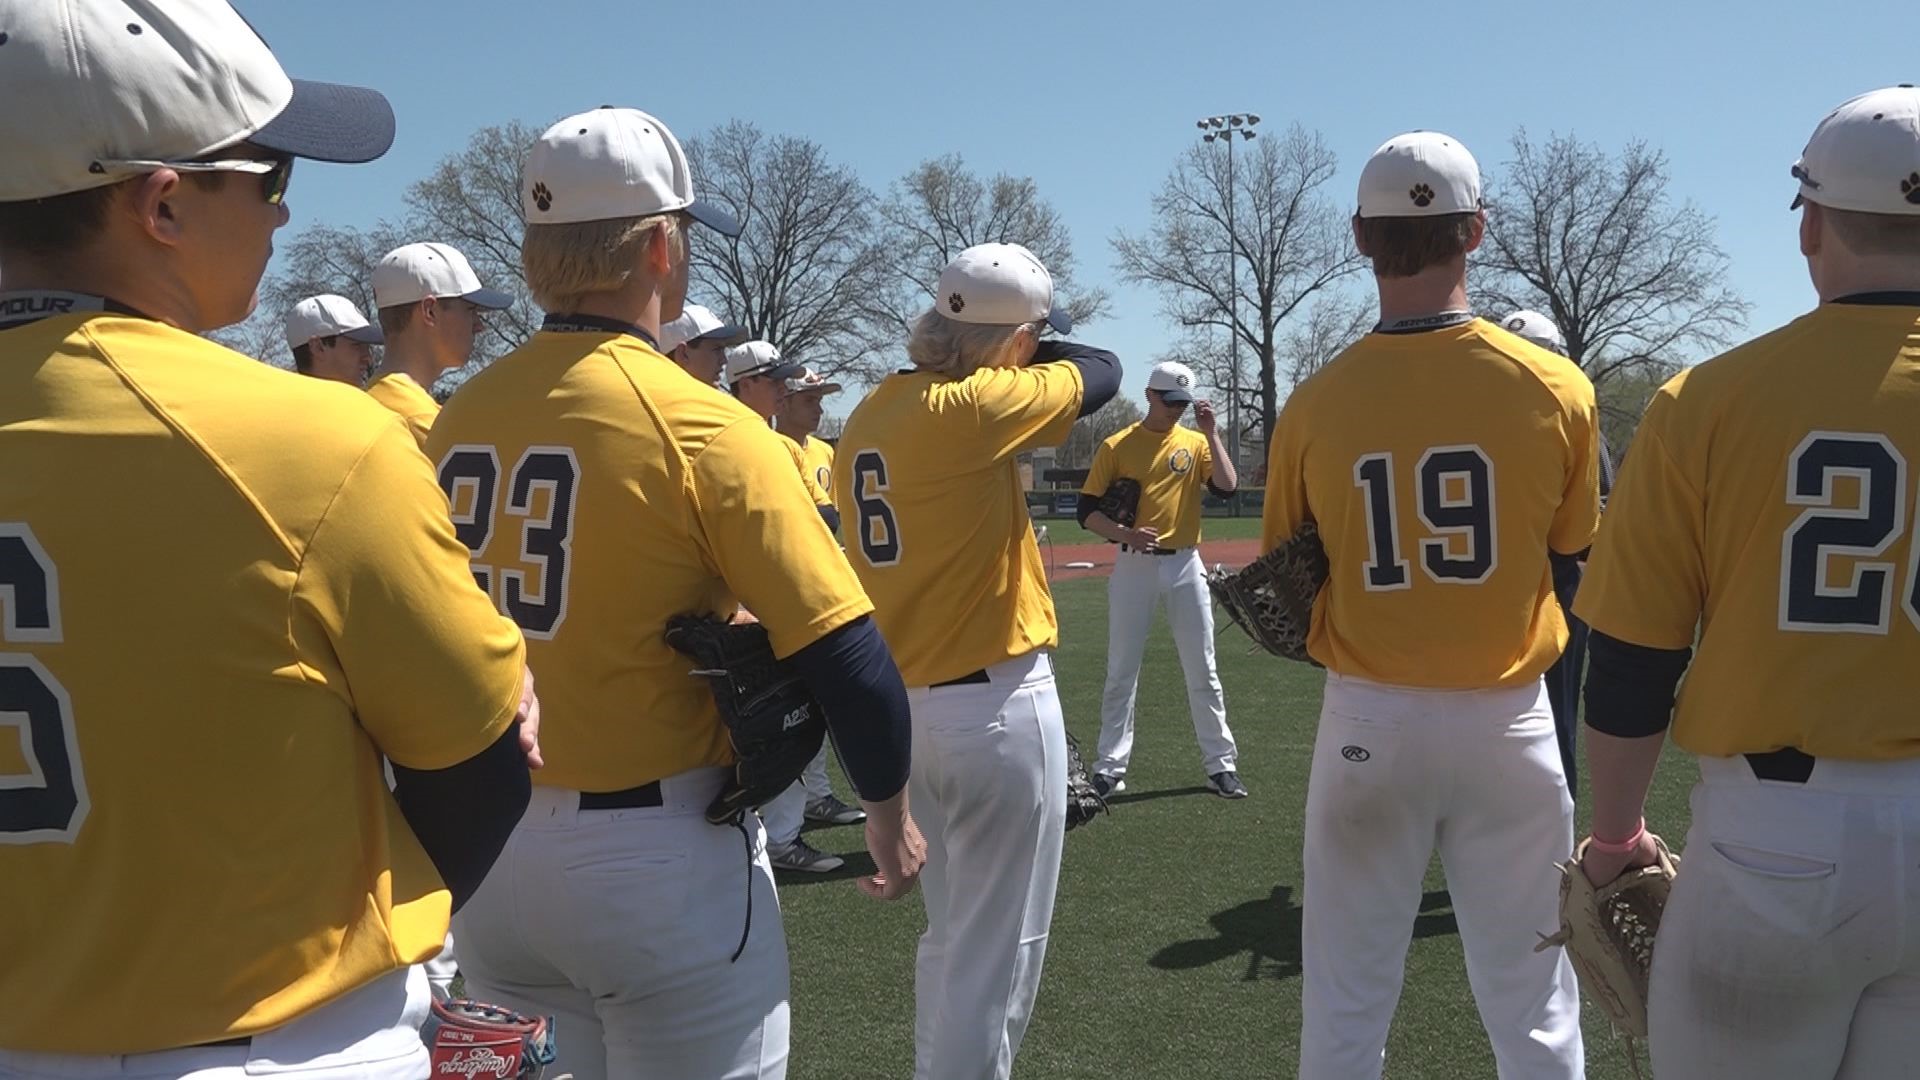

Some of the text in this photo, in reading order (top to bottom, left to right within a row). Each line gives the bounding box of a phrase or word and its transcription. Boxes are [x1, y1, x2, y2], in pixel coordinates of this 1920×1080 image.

[436, 444, 582, 641] 23
[853, 448, 903, 568] 6
[1353, 443, 1498, 592] 19
[1778, 430, 1920, 637] 2
[438, 1051, 515, 1079] Rawlings
